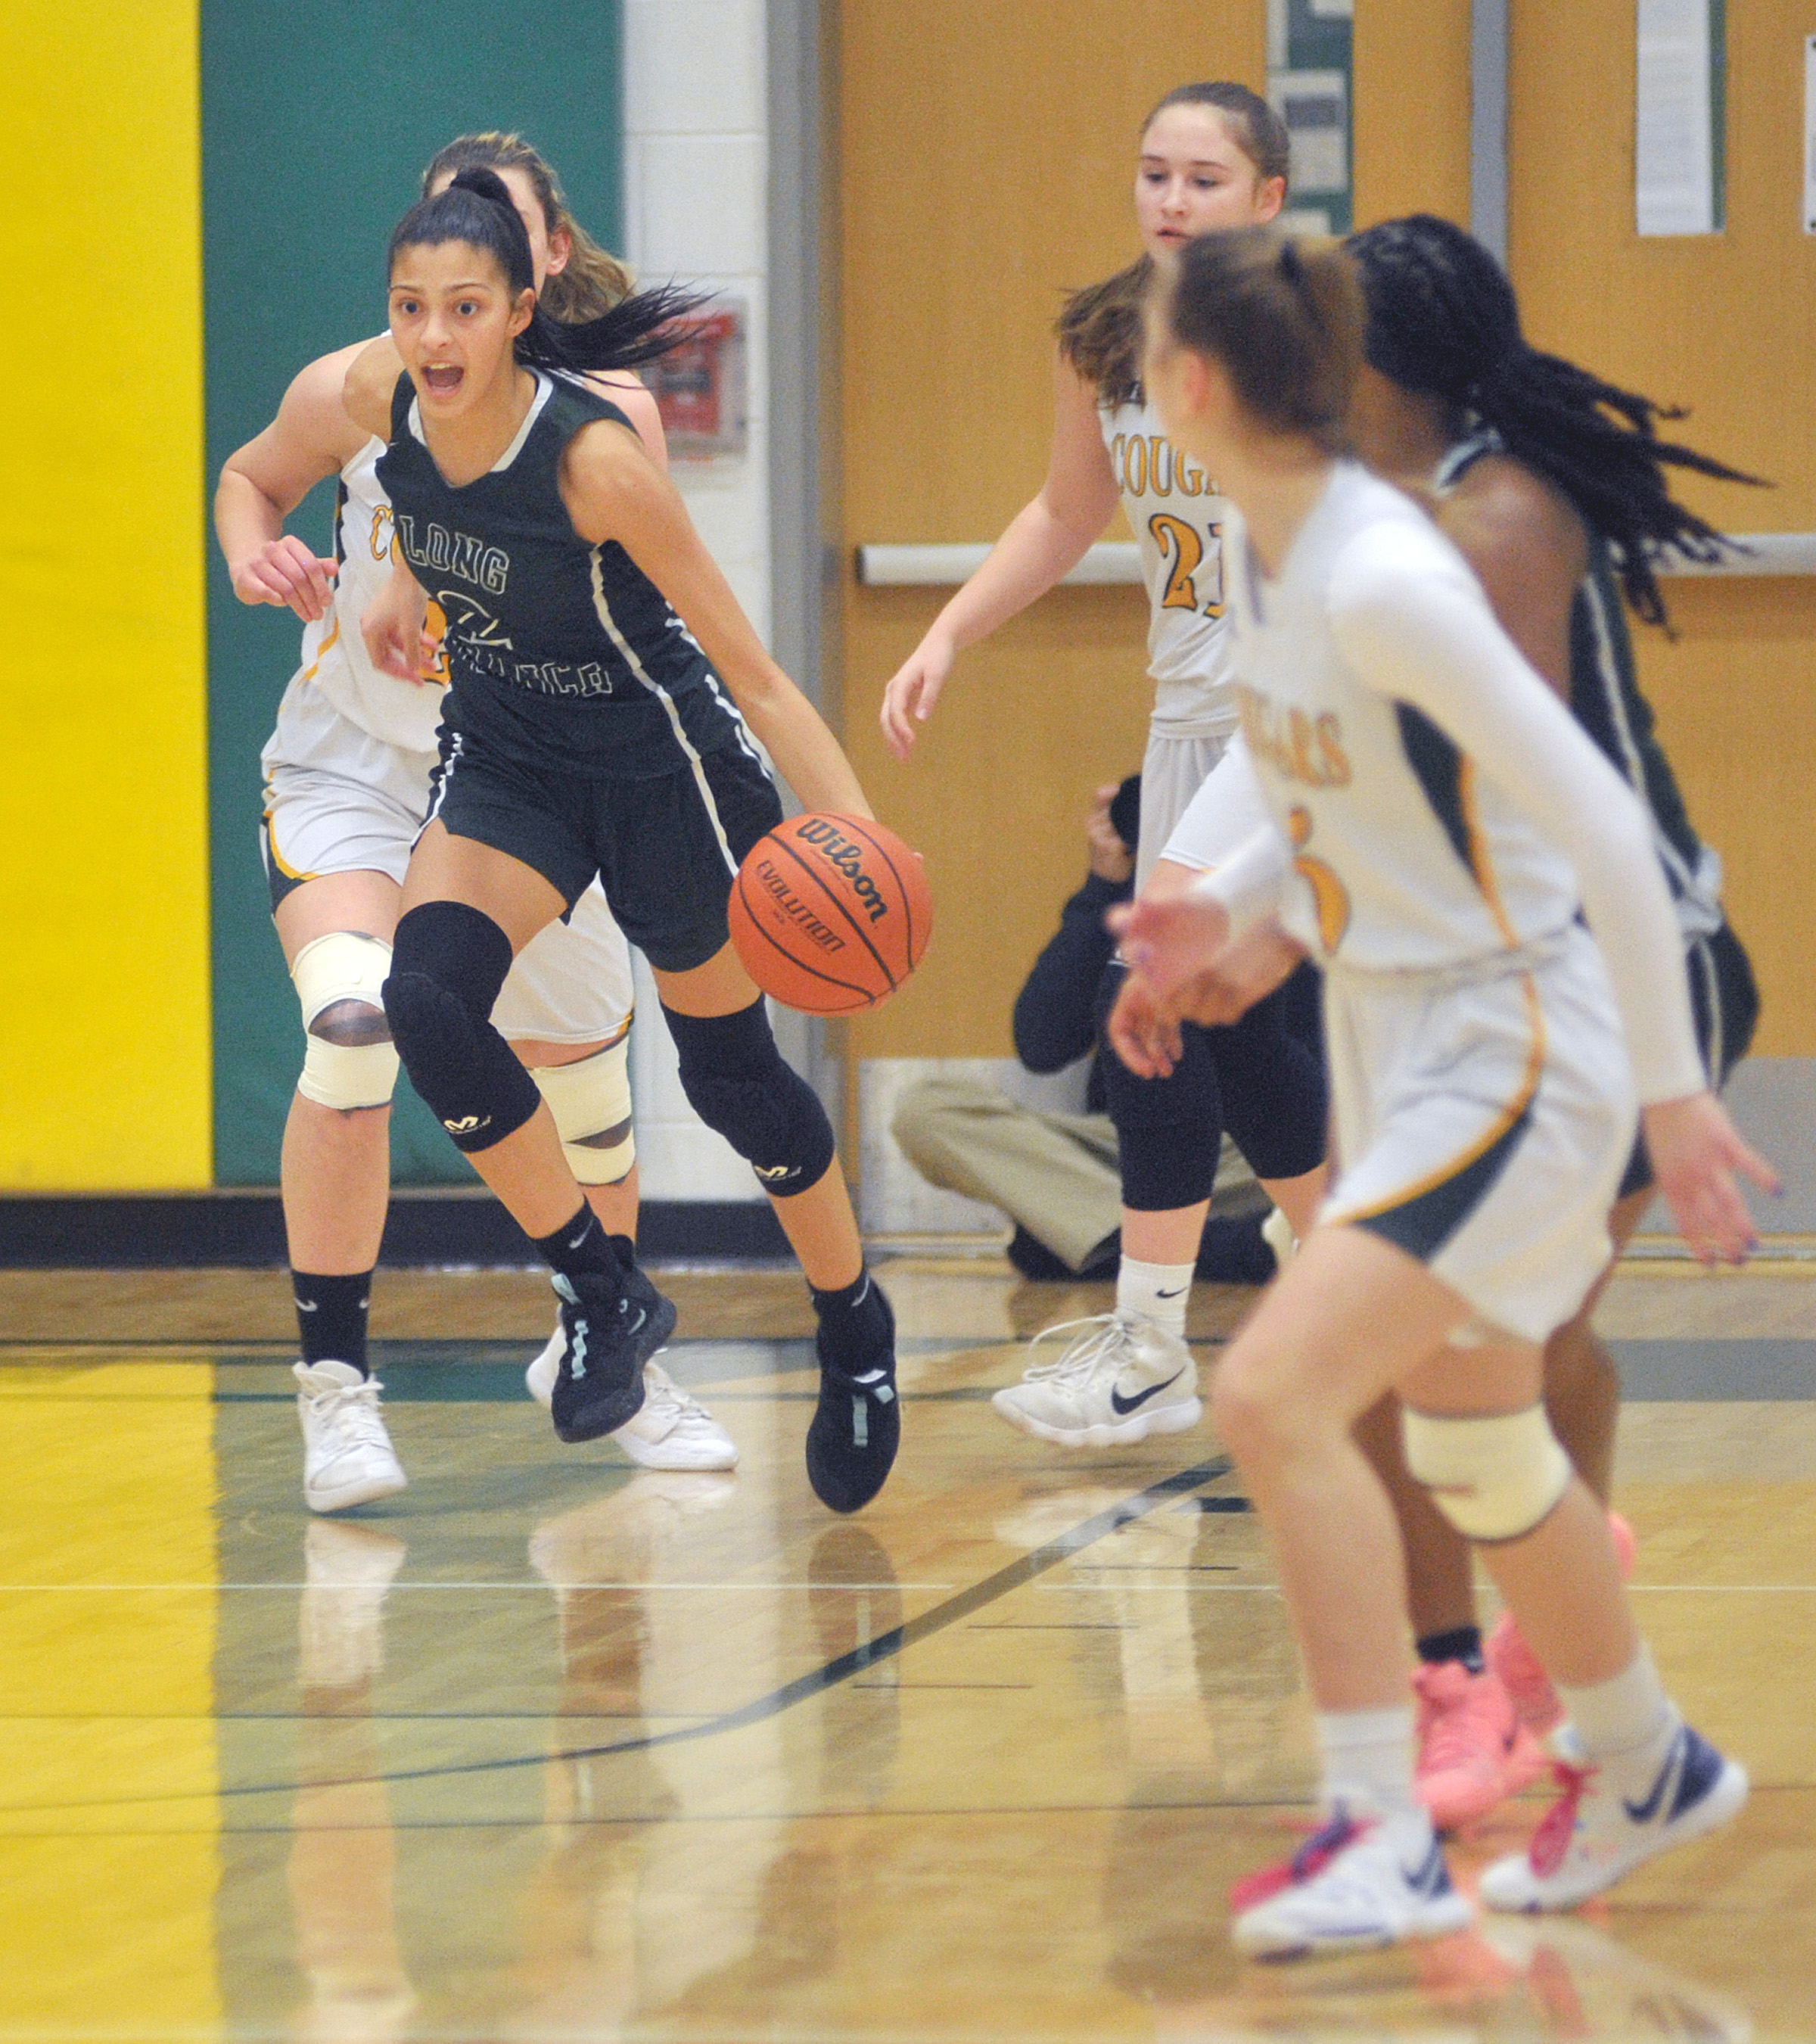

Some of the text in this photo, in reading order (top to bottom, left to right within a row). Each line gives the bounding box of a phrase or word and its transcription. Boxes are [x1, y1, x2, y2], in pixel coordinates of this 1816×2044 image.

[1112, 433, 1218, 497] COUG
[398, 514, 510, 596] LONG
[757, 859, 846, 953] EVOLUTION
[797, 818, 889, 924] Wilson
